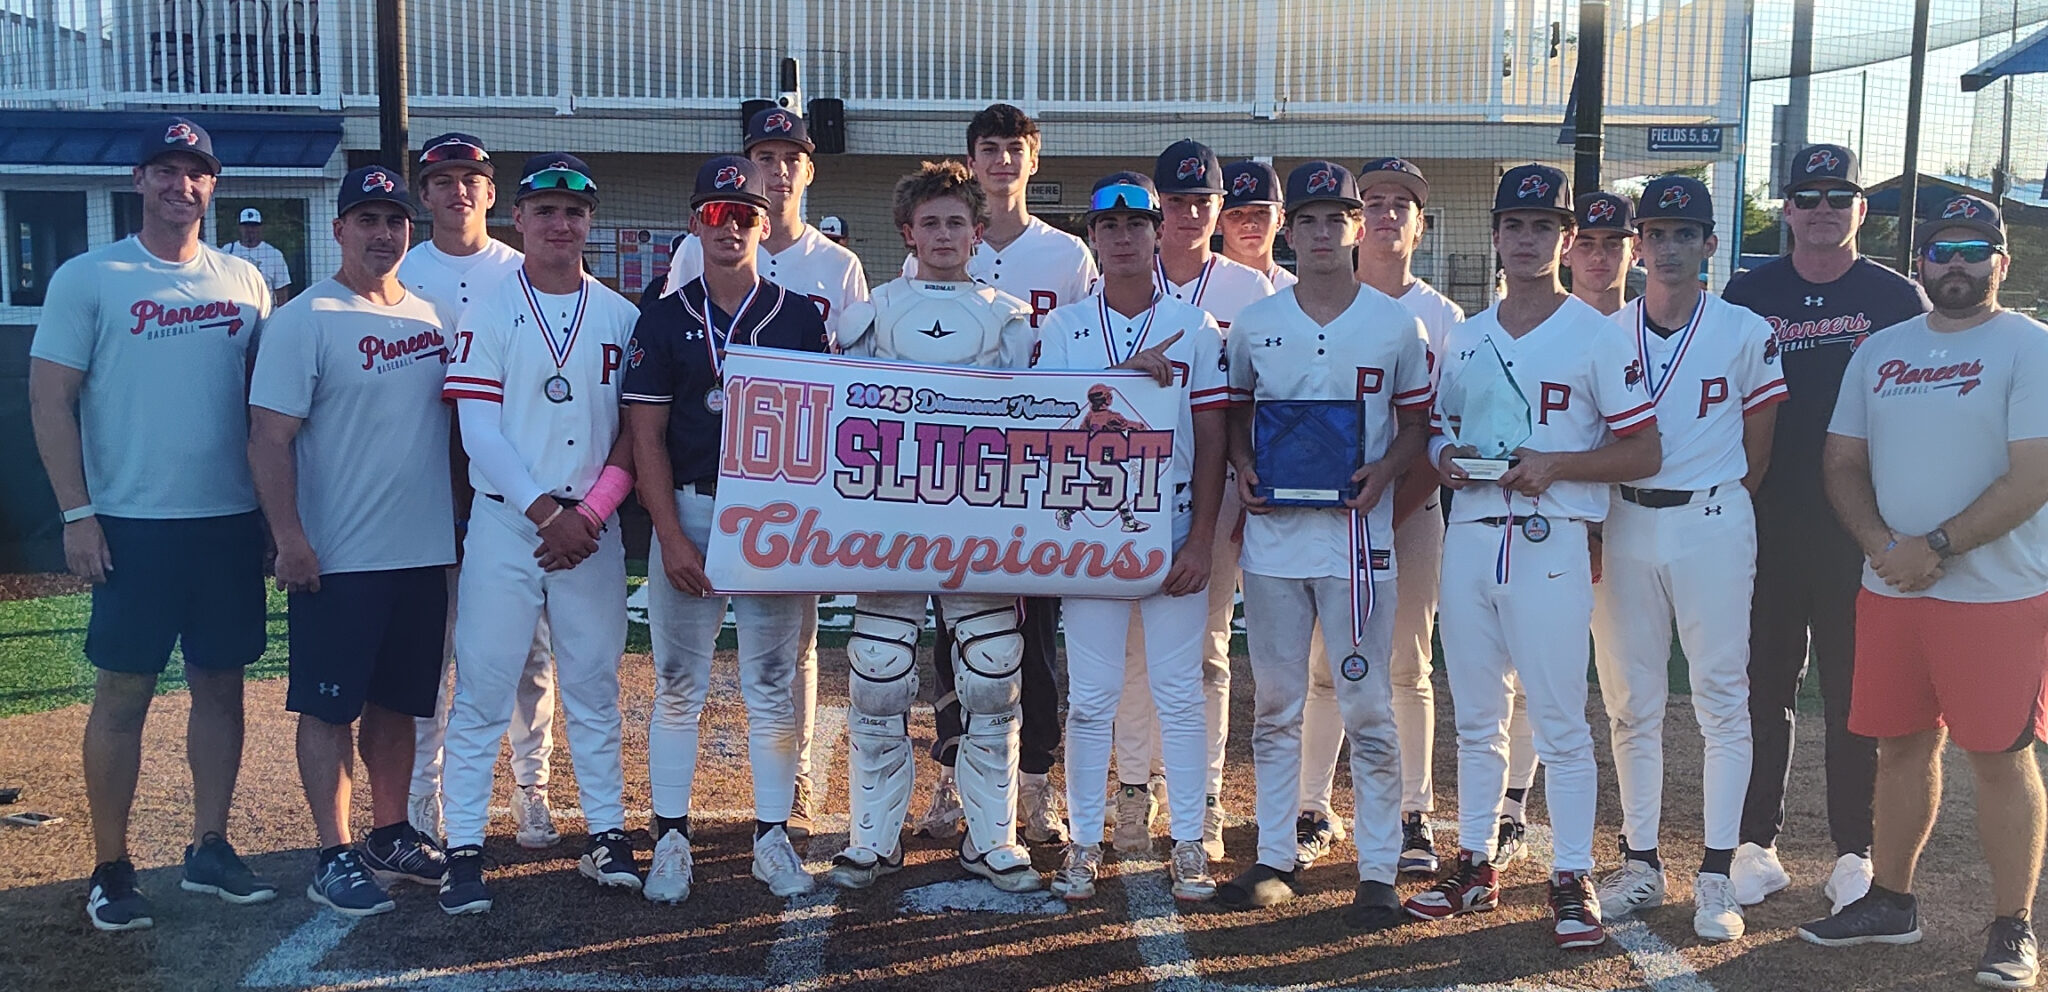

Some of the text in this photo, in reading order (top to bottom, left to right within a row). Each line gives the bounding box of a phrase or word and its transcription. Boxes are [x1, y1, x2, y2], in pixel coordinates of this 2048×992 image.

[1651, 129, 1687, 142] FIELDS
[1031, 186, 1059, 195] HERE
[130, 299, 241, 335] Pioneers
[147, 325, 196, 340] BASEBALL
[358, 328, 444, 371] Pioneers
[377, 357, 414, 374] BASEBALL
[601, 343, 623, 385] P
[1356, 366, 1384, 400] P
[1873, 358, 1984, 394] Pioneers
[1881, 385, 1929, 399] BASEBALL
[846, 382, 1080, 420] 2025 Diamond Nation
[1538, 381, 1571, 426] P
[1697, 376, 1728, 420] P
[721, 374, 834, 485] 16U
[834, 416, 1174, 512] SLUGFEST
[718, 502, 1165, 590] Champions
